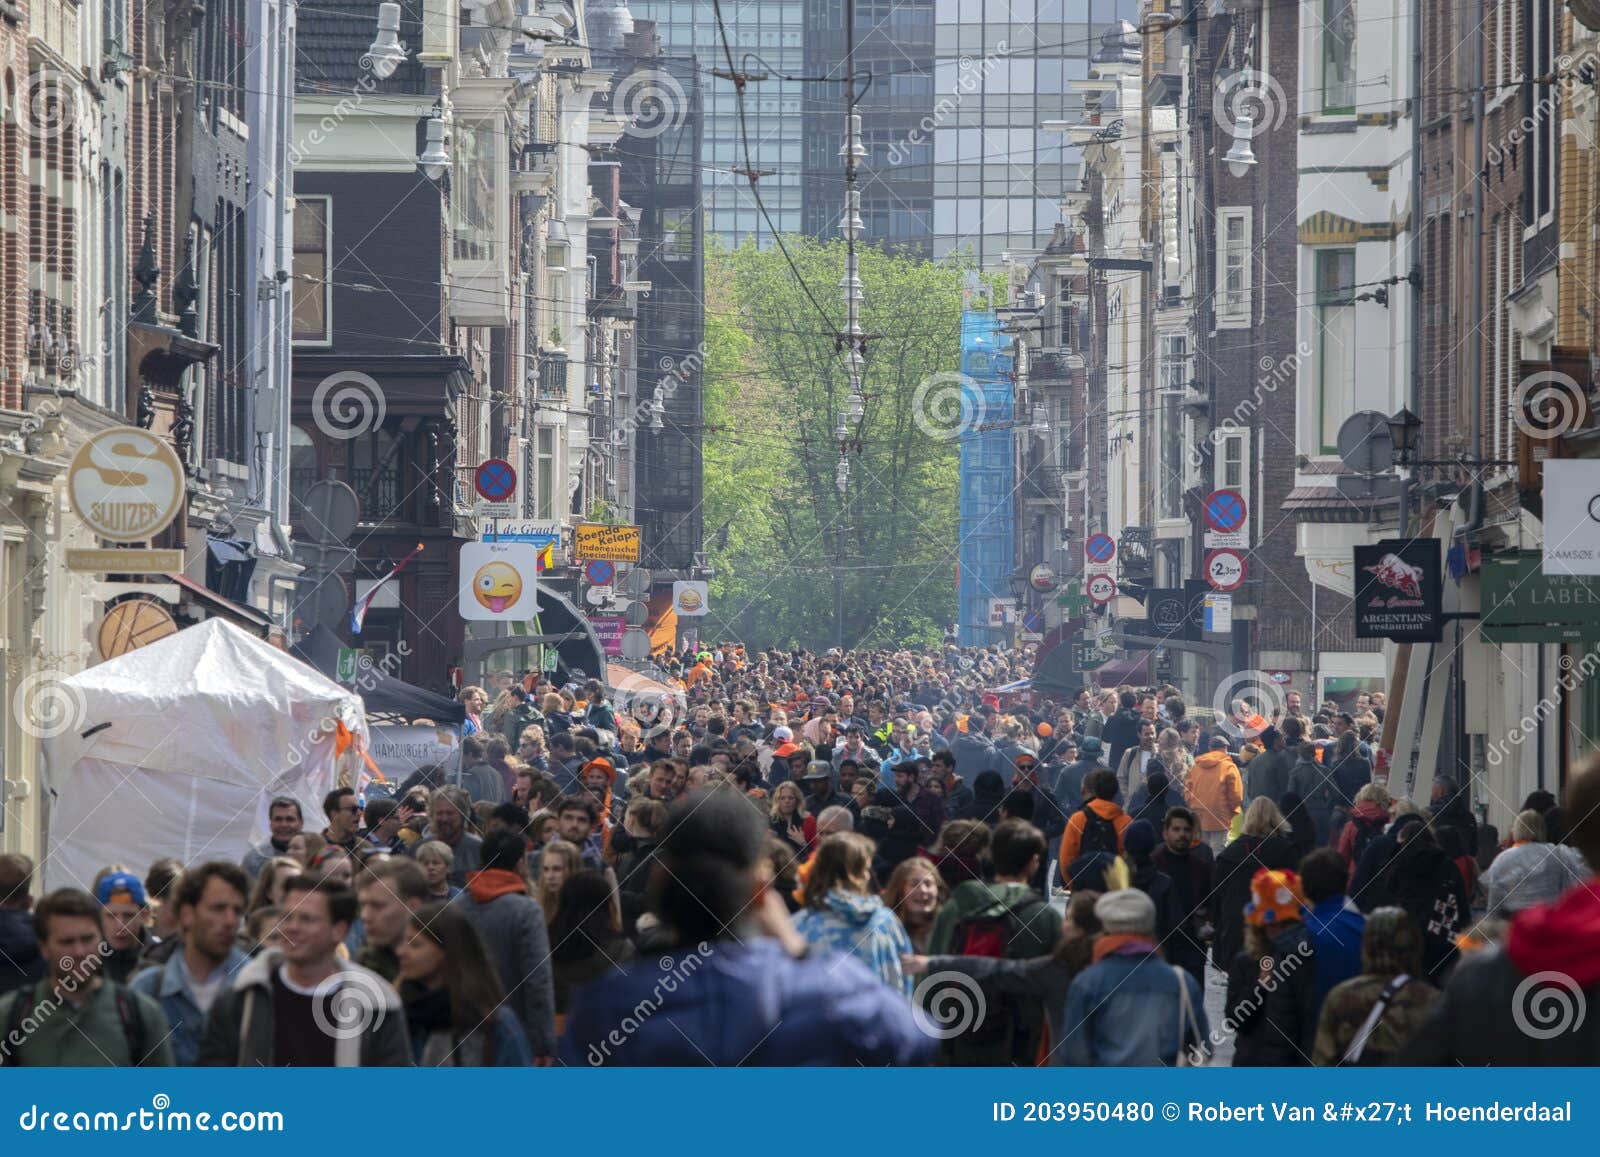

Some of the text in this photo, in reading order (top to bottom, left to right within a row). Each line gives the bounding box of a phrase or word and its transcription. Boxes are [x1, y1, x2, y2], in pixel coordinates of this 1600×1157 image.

[91, 502, 158, 530] SLUIZER
[504, 524, 517, 535] de
[520, 524, 557, 536] Graaf
[577, 526, 620, 542] Soenda
[599, 530, 640, 545] Kelapa
[1361, 613, 1433, 624] ARGENTIJNS
[1369, 622, 1424, 631] restaurant
